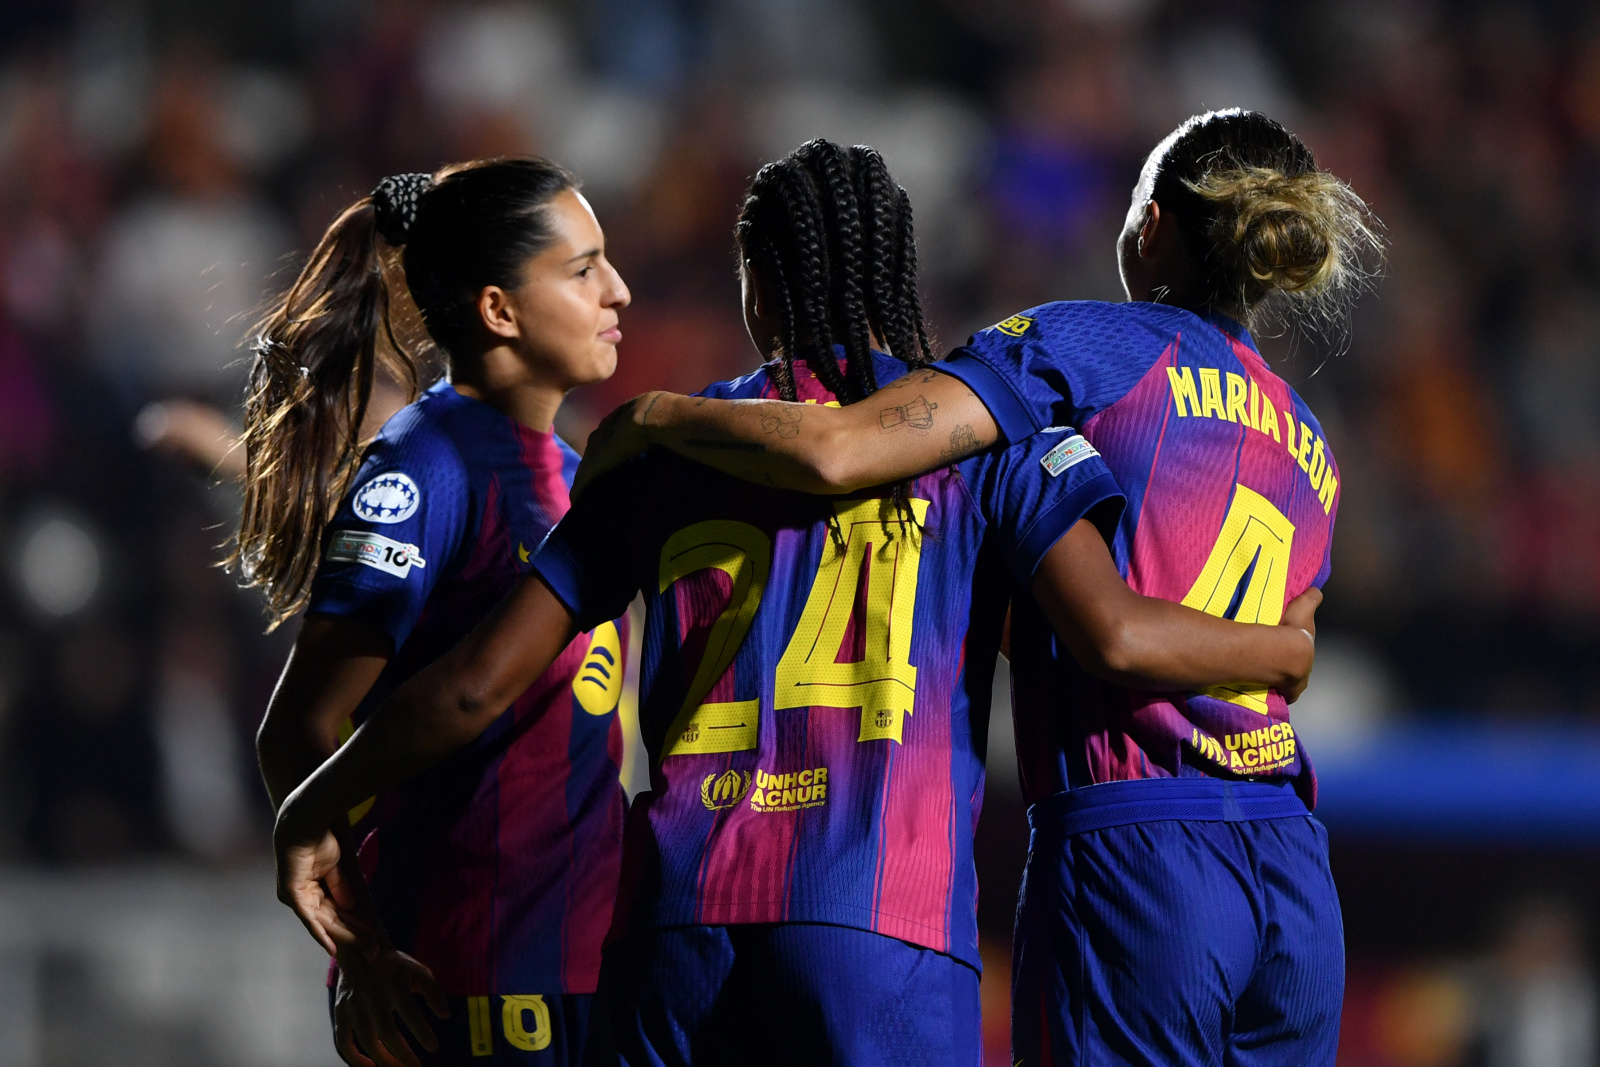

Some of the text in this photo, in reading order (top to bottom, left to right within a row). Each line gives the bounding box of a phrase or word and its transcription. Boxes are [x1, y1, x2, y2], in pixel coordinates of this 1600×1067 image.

[1284, 411, 1338, 516] LEÓN
[384, 546, 409, 568] 10
[1179, 483, 1296, 715] 4
[657, 498, 931, 764] 24
[1224, 722, 1295, 751] UNHCR
[1230, 739, 1296, 768] ACNUR
[1254, 763, 1278, 773] Refugee
[1279, 757, 1294, 767] Agency
[756, 767, 828, 790] UNHCR
[750, 783, 827, 806] ACNUR
[751, 803, 762, 812] The
[774, 804, 801, 812] Refugee
[802, 801, 825, 809] Agency
